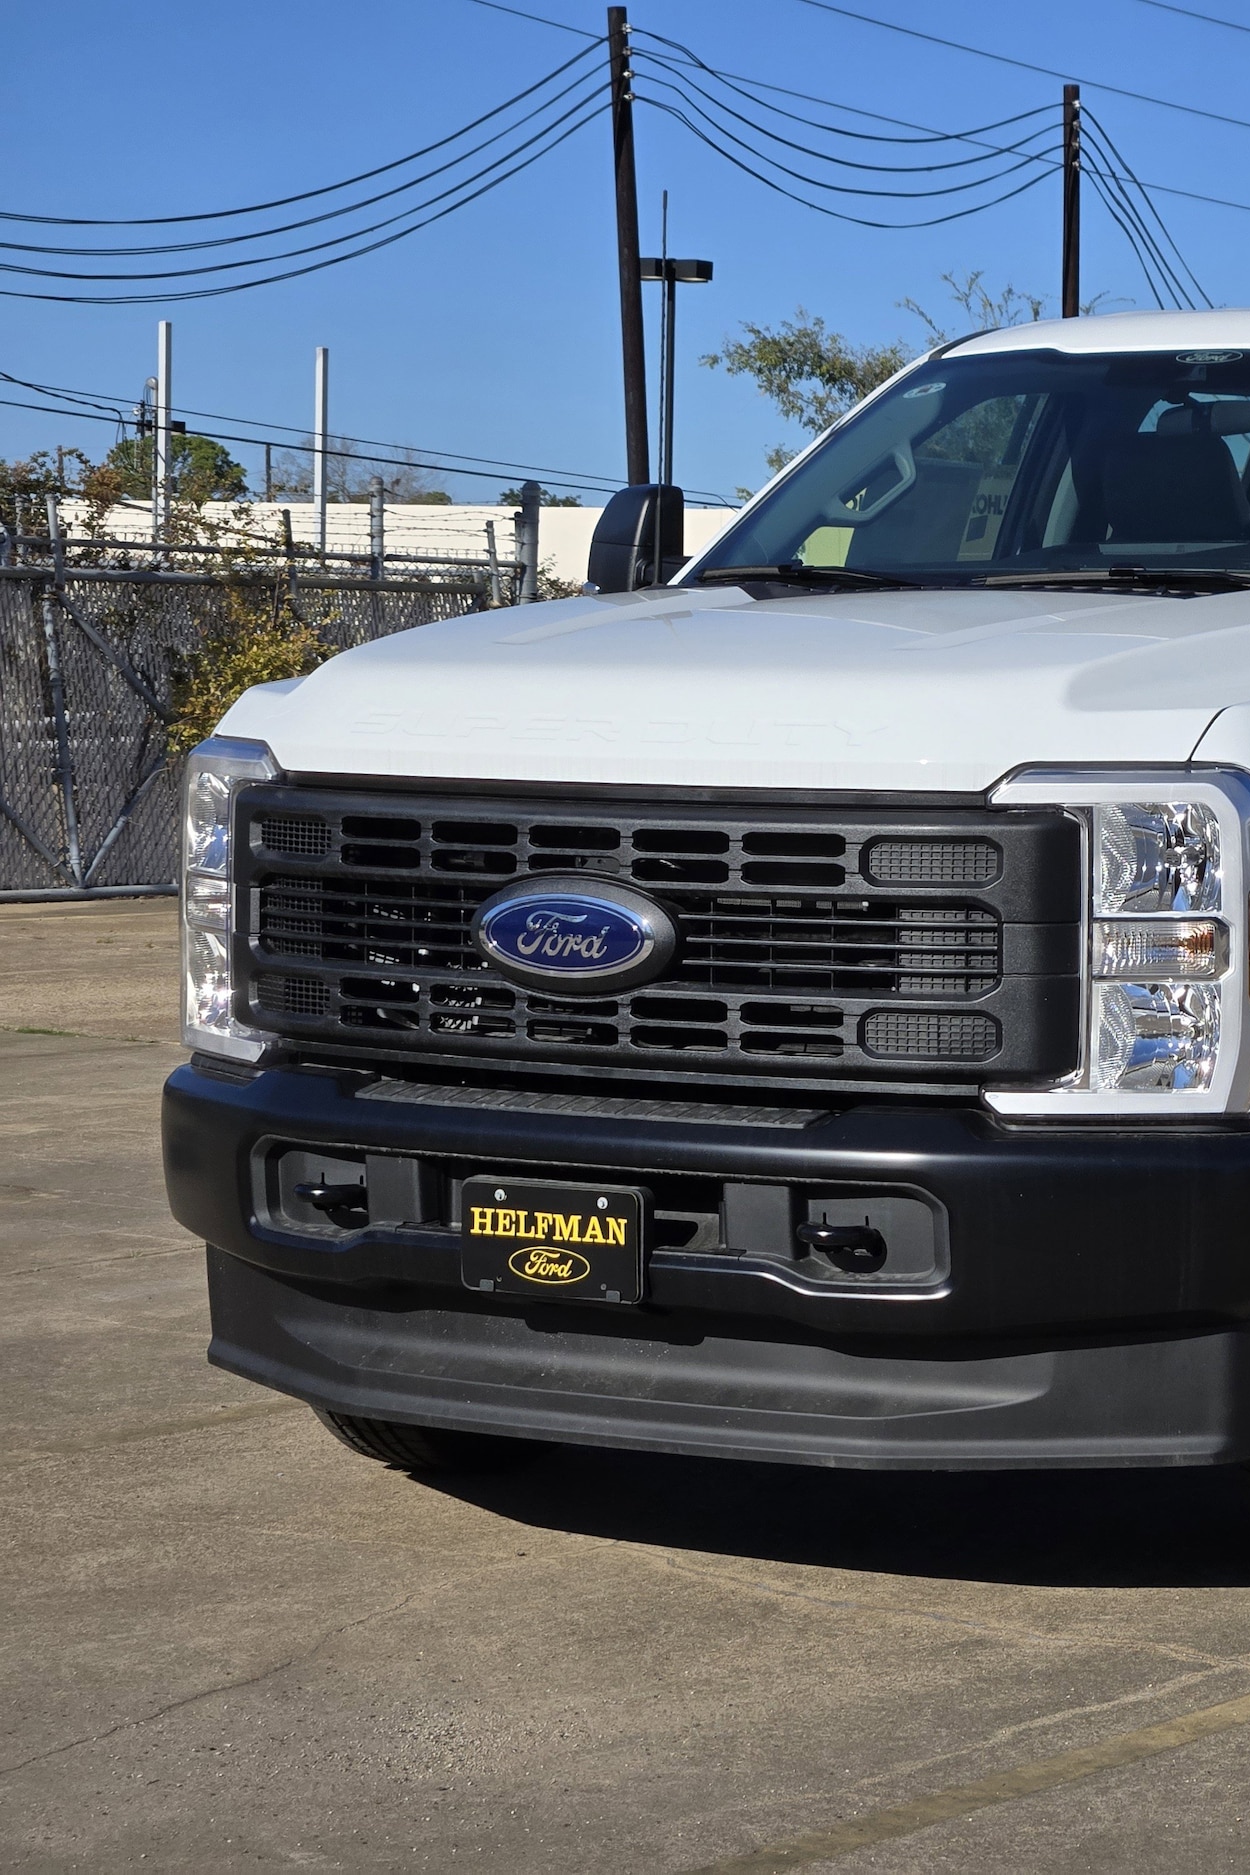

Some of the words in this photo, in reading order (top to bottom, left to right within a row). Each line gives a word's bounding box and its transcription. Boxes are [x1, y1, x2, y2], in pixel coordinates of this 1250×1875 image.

[350, 711, 621, 743] SUPER
[640, 719, 889, 747] DUTY
[517, 909, 611, 959] Ford
[470, 1206, 628, 1246] HELFMAN
[524, 1250, 573, 1278] Ford
